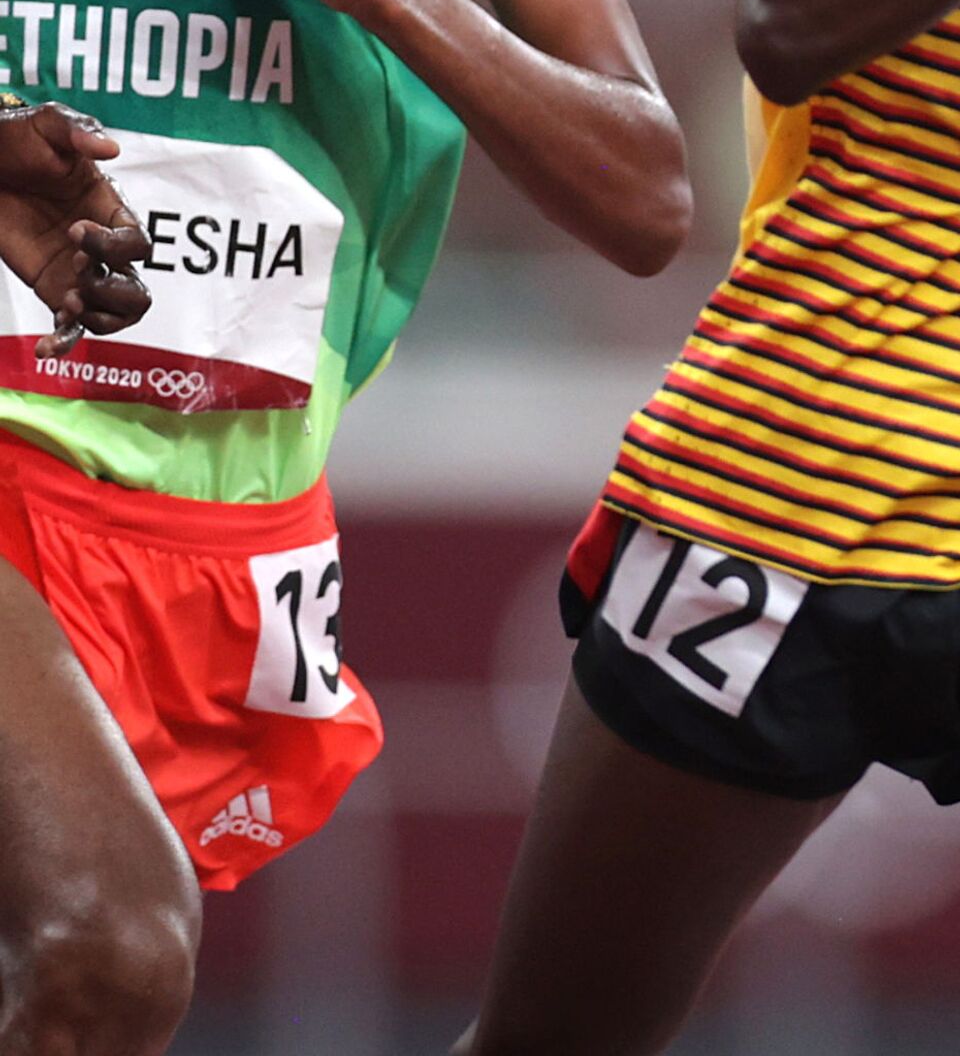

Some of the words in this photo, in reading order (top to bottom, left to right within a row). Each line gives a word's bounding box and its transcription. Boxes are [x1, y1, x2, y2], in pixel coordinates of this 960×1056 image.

[0, 0, 294, 104] THIOPIA
[35, 357, 94, 381] TOKYO
[95, 365, 142, 387] 2020
[631, 530, 768, 692] 12
